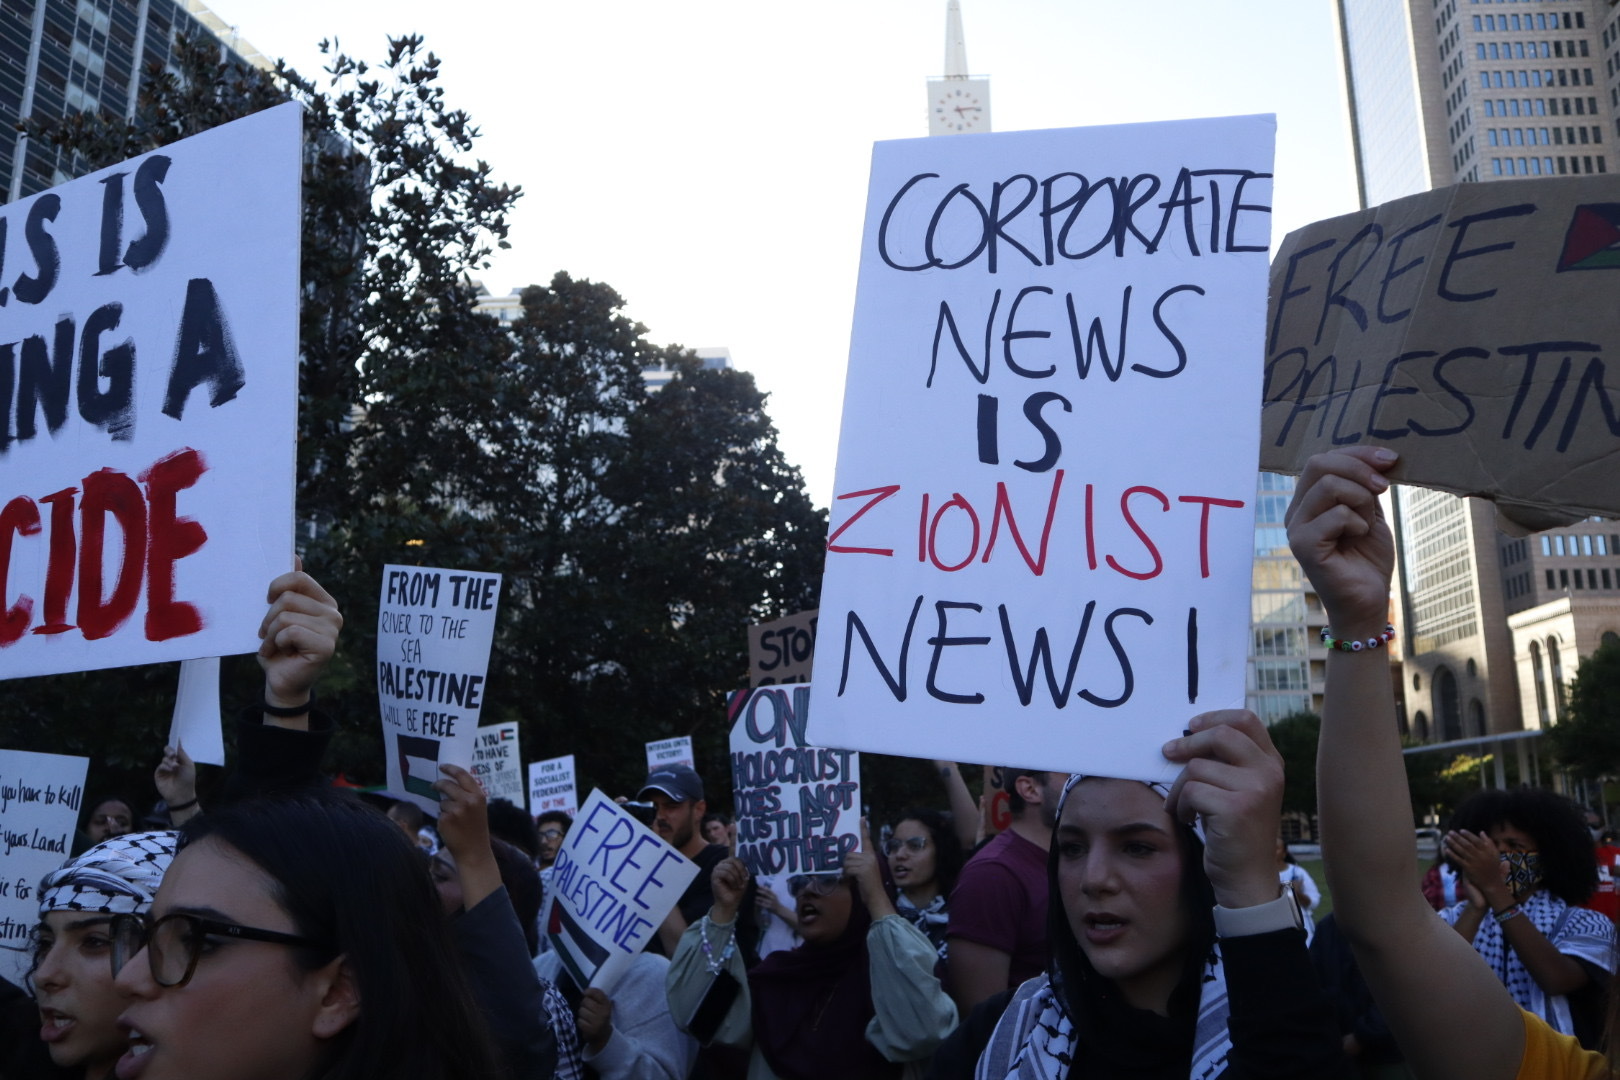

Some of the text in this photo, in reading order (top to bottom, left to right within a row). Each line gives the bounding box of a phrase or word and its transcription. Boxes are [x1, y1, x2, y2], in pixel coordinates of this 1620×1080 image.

[92, 154, 172, 276] IS
[879, 166, 1273, 273] CORPORATE
[1268, 203, 1538, 356] FREE
[161, 277, 246, 421] A
[926, 284, 1205, 388] NEWS
[977, 391, 1073, 473] IS
[826, 469, 1245, 580] ZIONIST
[0, 445, 209, 647] CIDE
[387, 571, 497, 611] FROM THE
[381, 611, 469, 639] RIVER TO THE
[401, 638, 421, 664] SEA
[379, 661, 483, 710] PALESTINE
[383, 704, 459, 737] WILL BE FREE
[746, 687, 811, 748] ON
[481, 733, 499, 747] YOU
[534, 771, 570, 786] SOCIALIST
[541, 761, 562, 773] FOR A
[730, 747, 856, 789] HOLOCAUST
[2, 786, 17, 814] you
[18, 778, 41, 803] have
[45, 785, 55, 803] to
[532, 784, 573, 799] FEDERATION
[733, 781, 858, 821] DOES NOT
[31, 827, 66, 854] Land
[738, 809, 840, 843] JUSTIFY
[572, 800, 684, 910] FREE
[15, 879, 32, 900] for
[552, 848, 654, 954] PALESTINE
